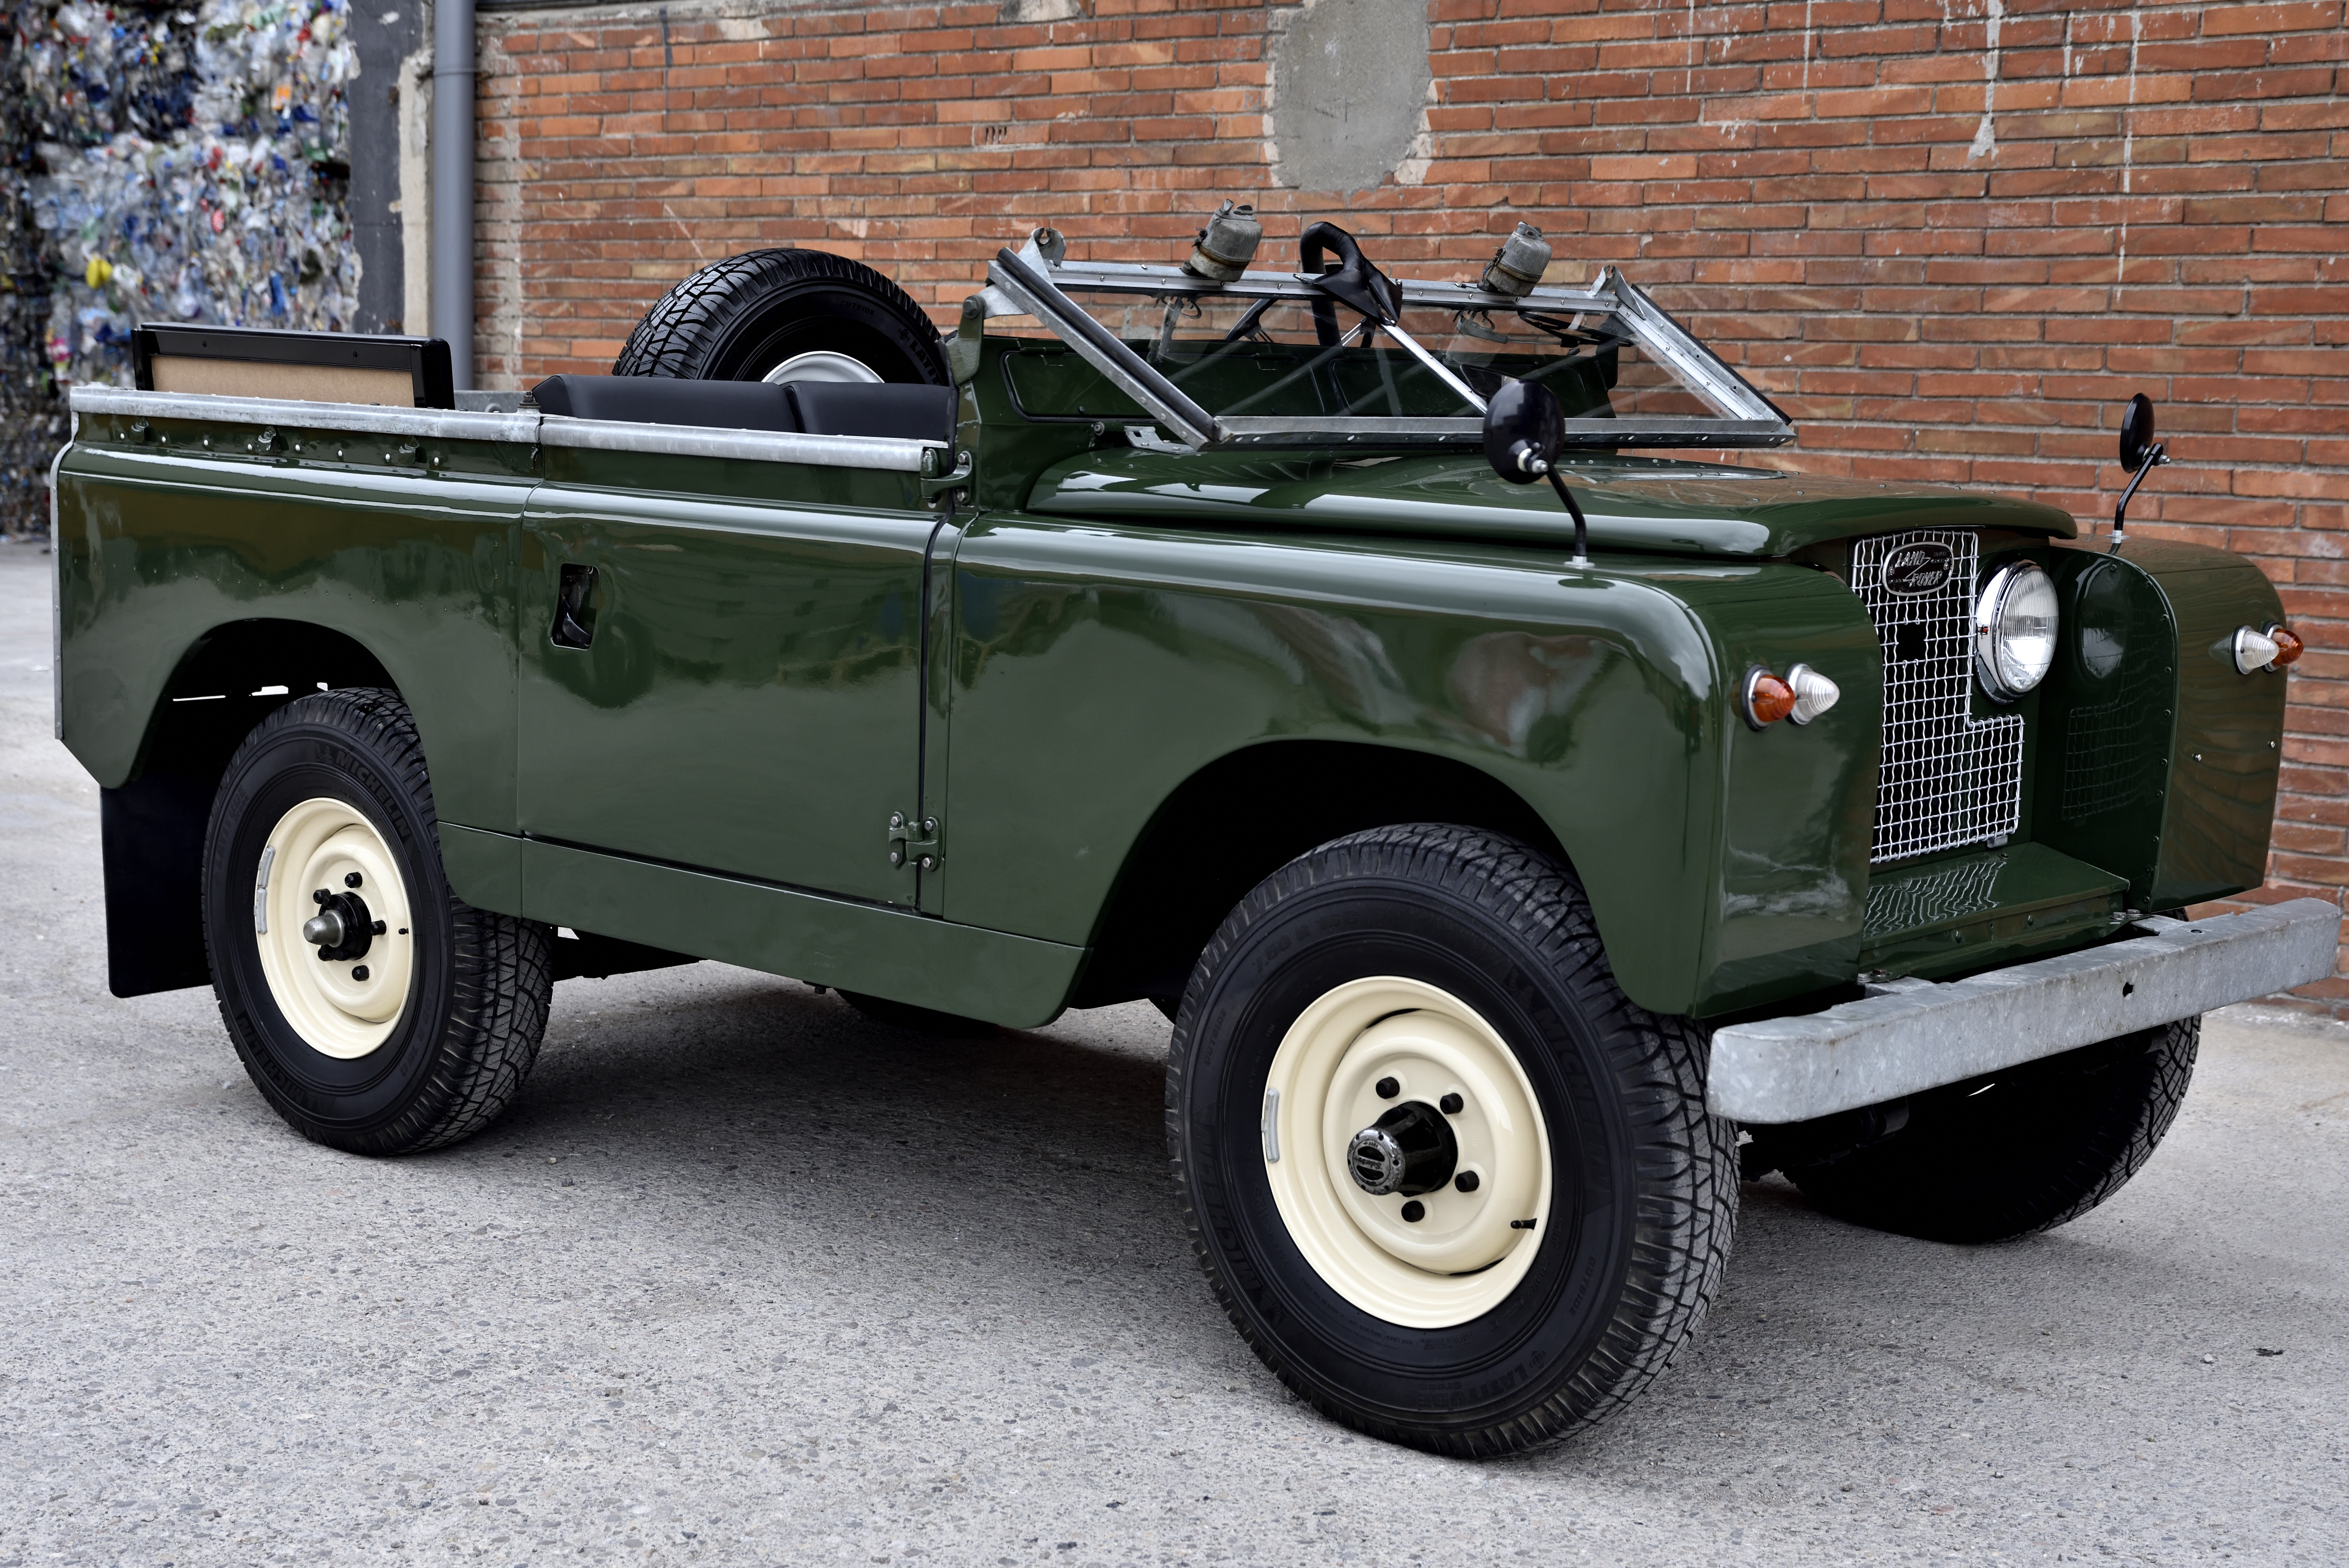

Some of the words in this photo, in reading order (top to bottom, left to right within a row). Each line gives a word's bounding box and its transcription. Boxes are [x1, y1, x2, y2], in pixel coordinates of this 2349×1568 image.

[840, 300, 875, 316] OUTSIDE
[909, 340, 944, 385] LATIT
[1895, 550, 1925, 568] LAND
[1909, 570, 1943, 587] ROVER
[336, 750, 411, 837] MICHELIN
[215, 784, 247, 869] LATITUDE
[1251, 934, 1292, 974] 7.50
[1295, 924, 1311, 941] R
[237, 1017, 305, 1104] MICHELIN
[1204, 1007, 1228, 1066] OUTSIDE
[1533, 1007, 1611, 1192] MICHELIN
[1358, 1157, 1382, 1170] Selectro
[1194, 1124, 1262, 1291] MICHELIN
[1300, 1276, 1313, 1291] COLD
[1568, 1255, 1596, 1317] OUTSIDE
[1418, 1362, 1529, 1408] LATITUDE
